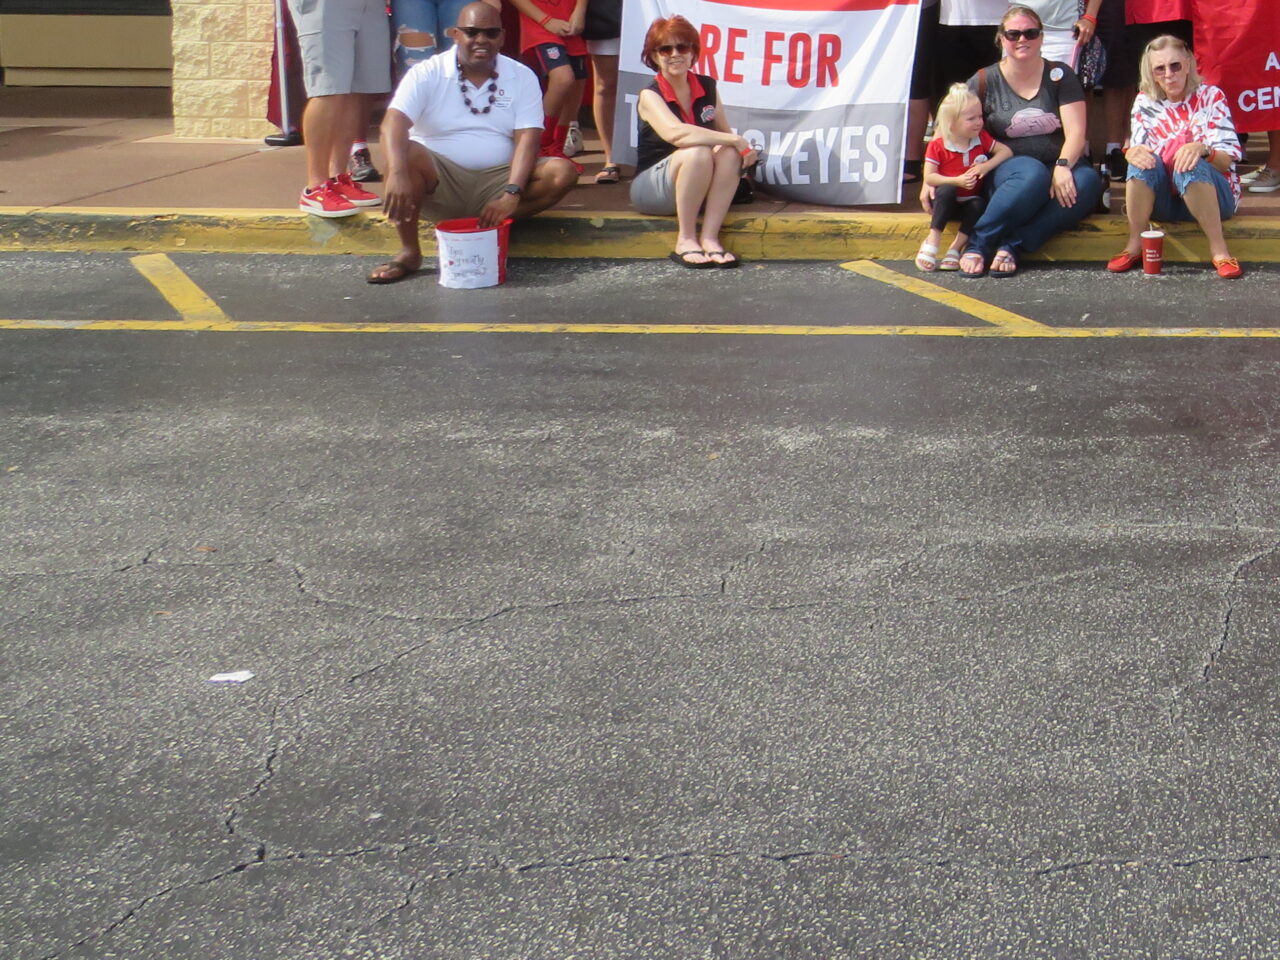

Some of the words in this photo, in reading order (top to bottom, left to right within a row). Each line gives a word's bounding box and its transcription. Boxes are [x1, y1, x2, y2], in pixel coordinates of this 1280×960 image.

[690, 24, 748, 83] RE
[761, 31, 842, 88] FOR
[731, 124, 890, 185] CKEYES
